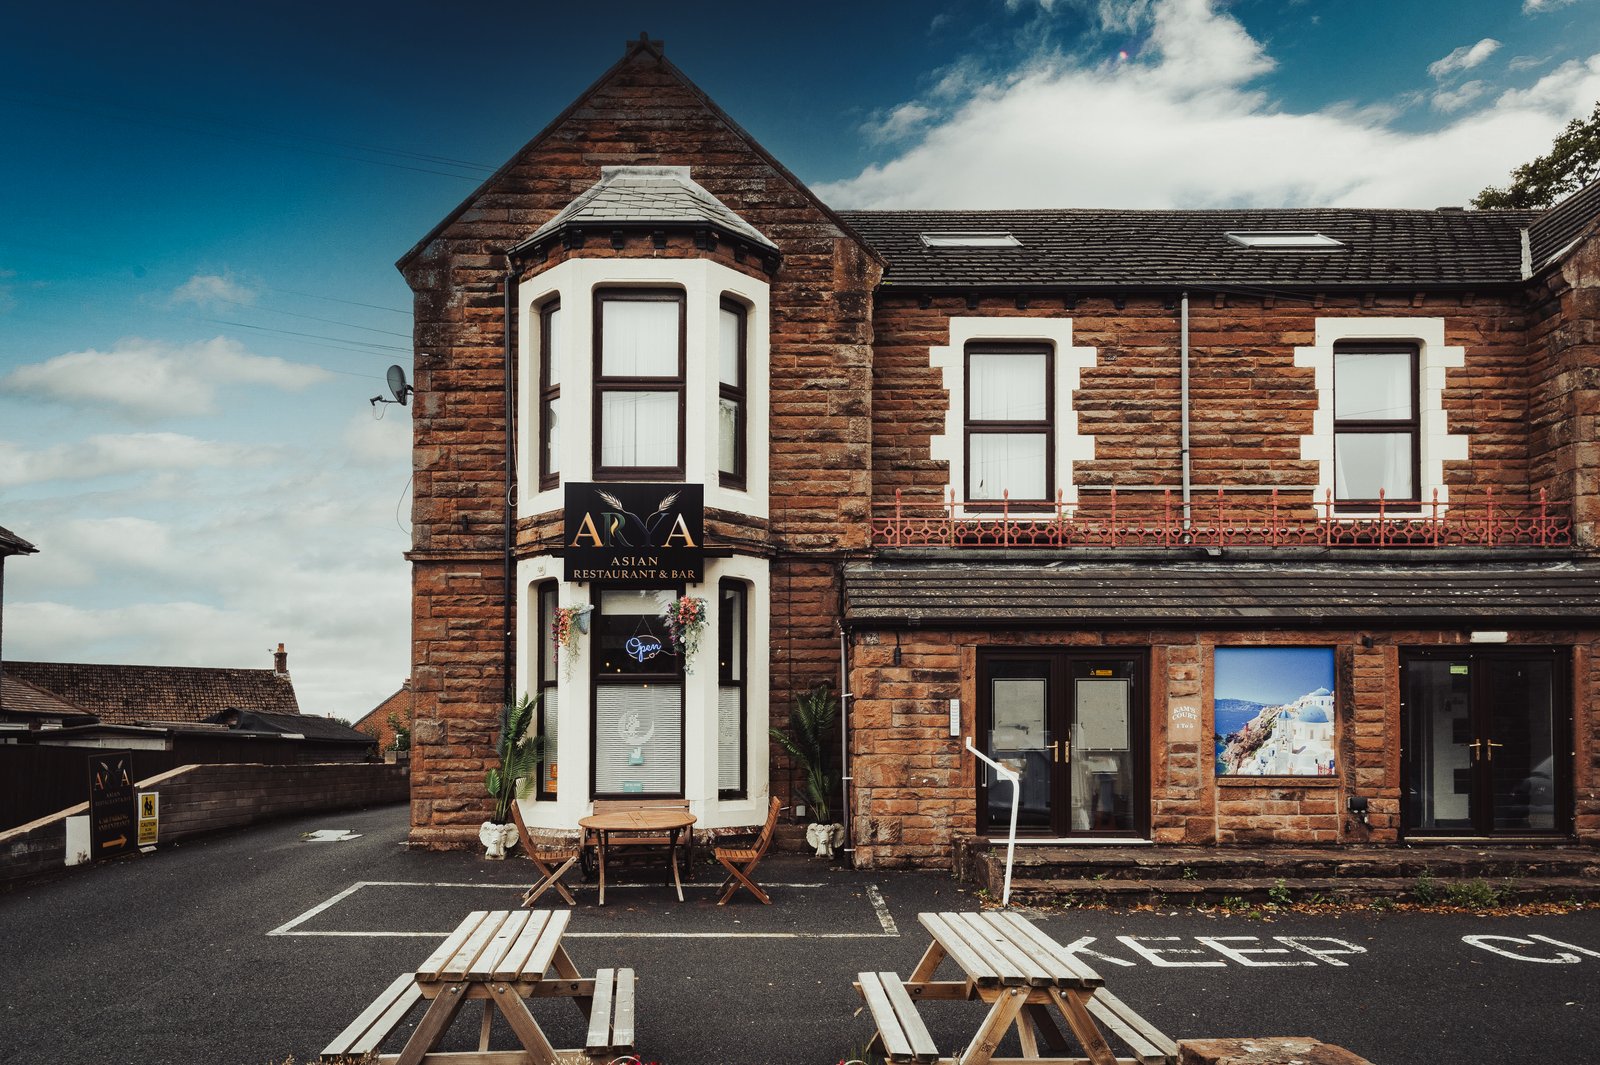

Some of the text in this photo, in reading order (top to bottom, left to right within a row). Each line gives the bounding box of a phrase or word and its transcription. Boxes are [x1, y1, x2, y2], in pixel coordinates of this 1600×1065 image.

[568, 511, 698, 548] ARYA
[611, 556, 659, 566] ASIAN
[573, 569, 696, 579] RESTAURANT & BAR
[625, 637, 662, 662] Open
[1172, 712, 1198, 721] COURT
[1064, 936, 1367, 968] KEEP
